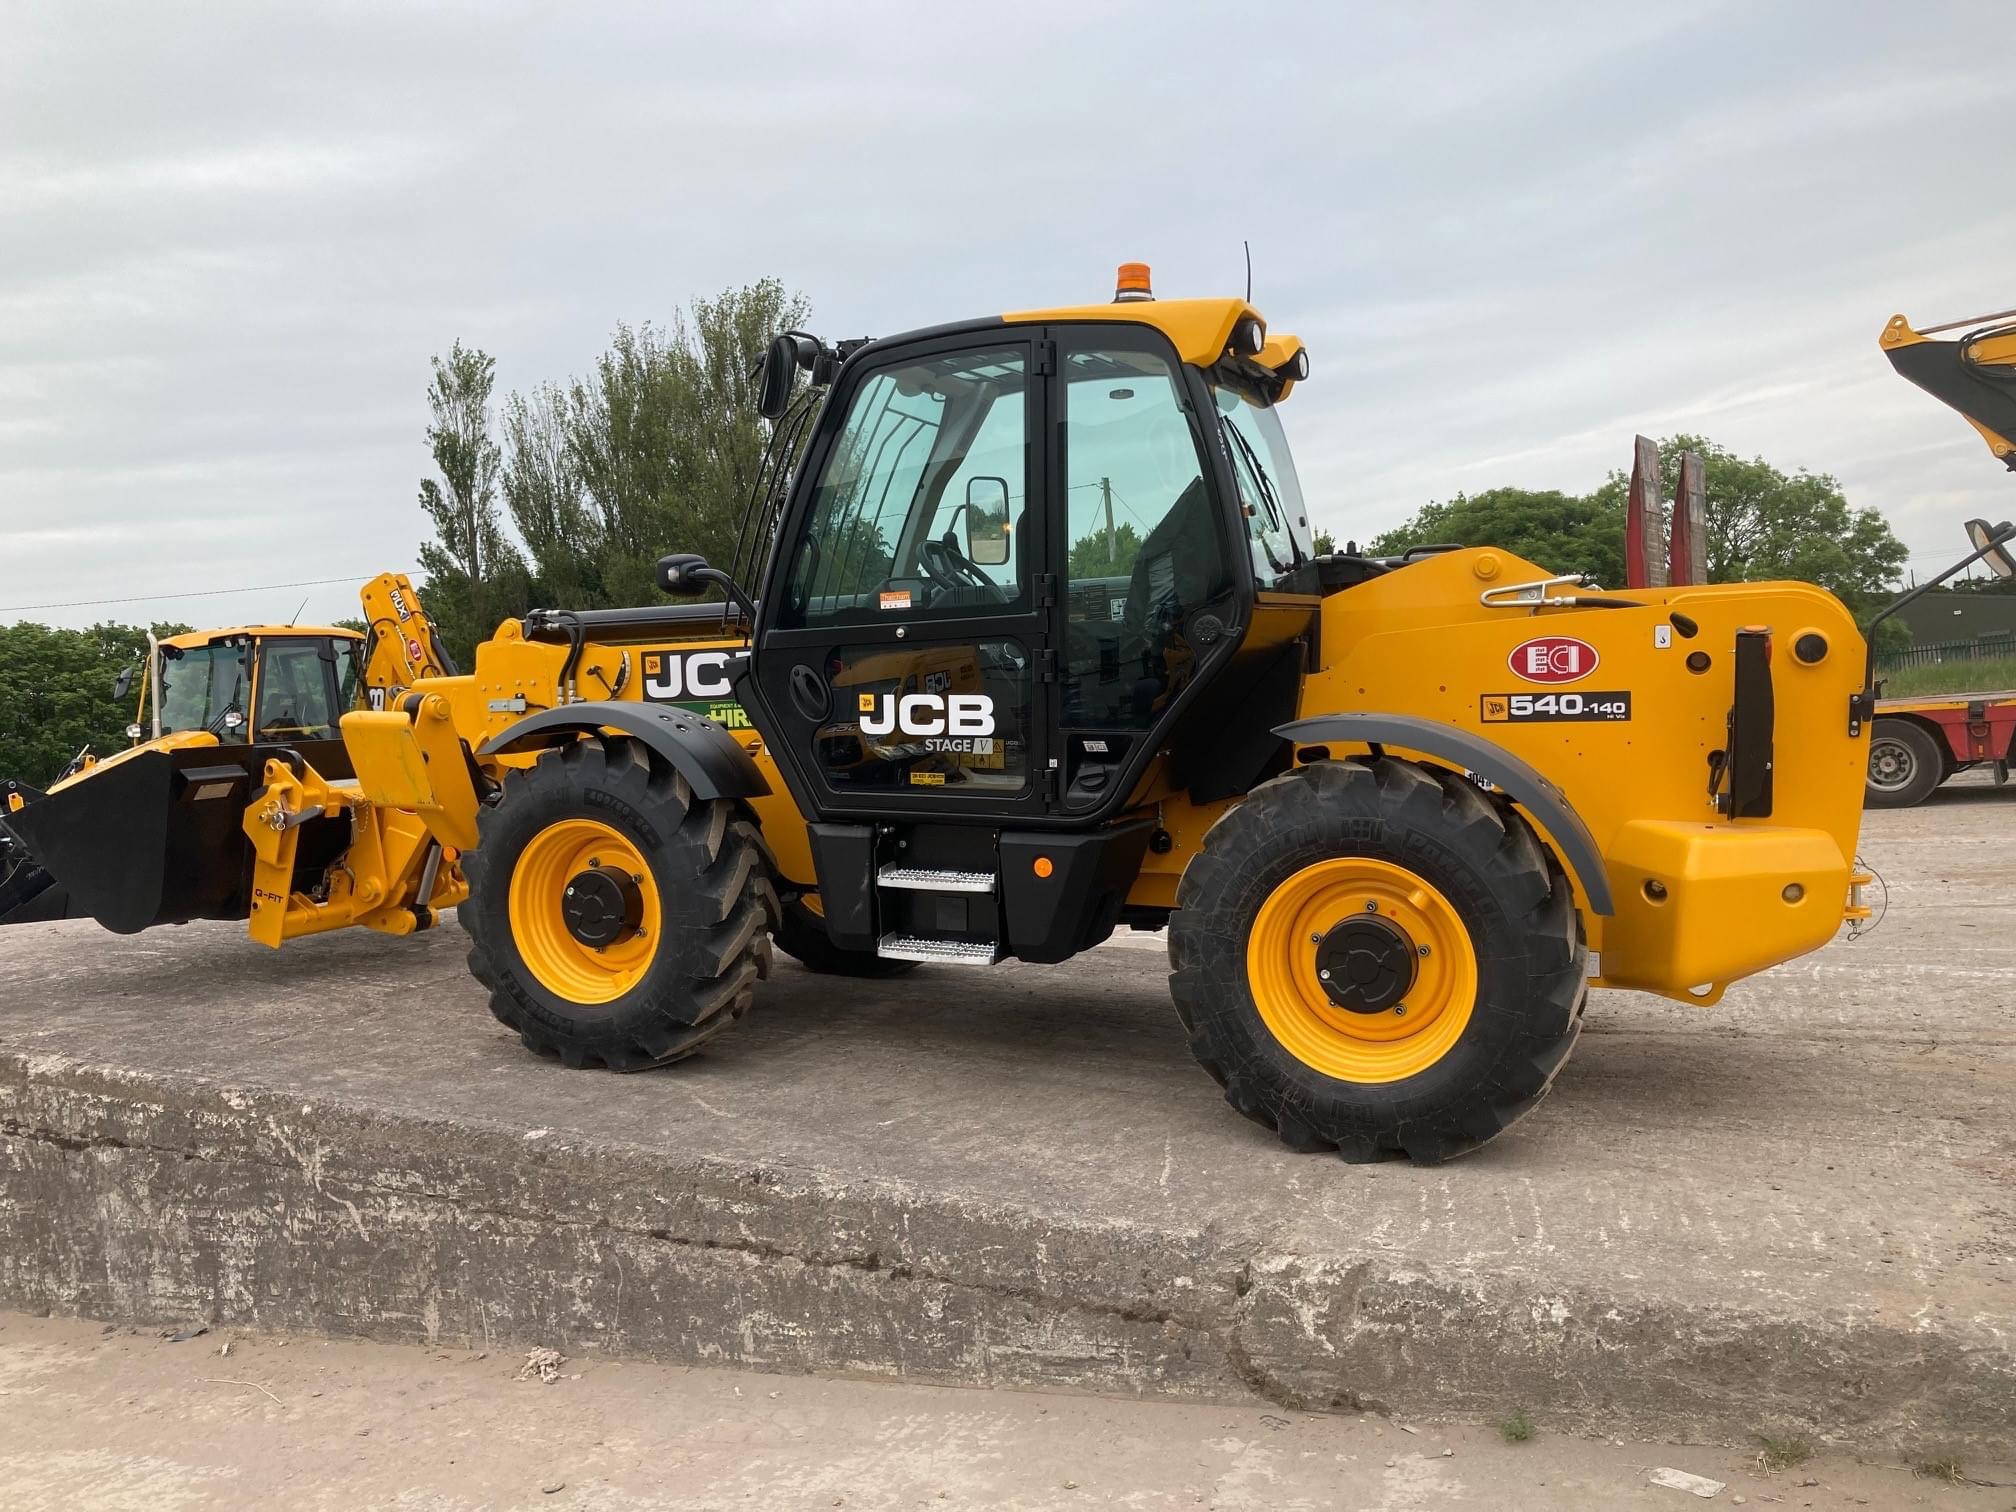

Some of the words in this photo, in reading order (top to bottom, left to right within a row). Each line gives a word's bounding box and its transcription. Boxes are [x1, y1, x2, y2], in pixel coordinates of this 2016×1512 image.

[1527, 645, 1579, 674] ECI
[646, 651, 752, 698] JC
[859, 694, 995, 735] JCB
[1510, 694, 1625, 716] 540-140
[711, 709, 752, 728] HIR
[925, 738, 971, 752] STAGE
[256, 889, 283, 903] Q-FIT
